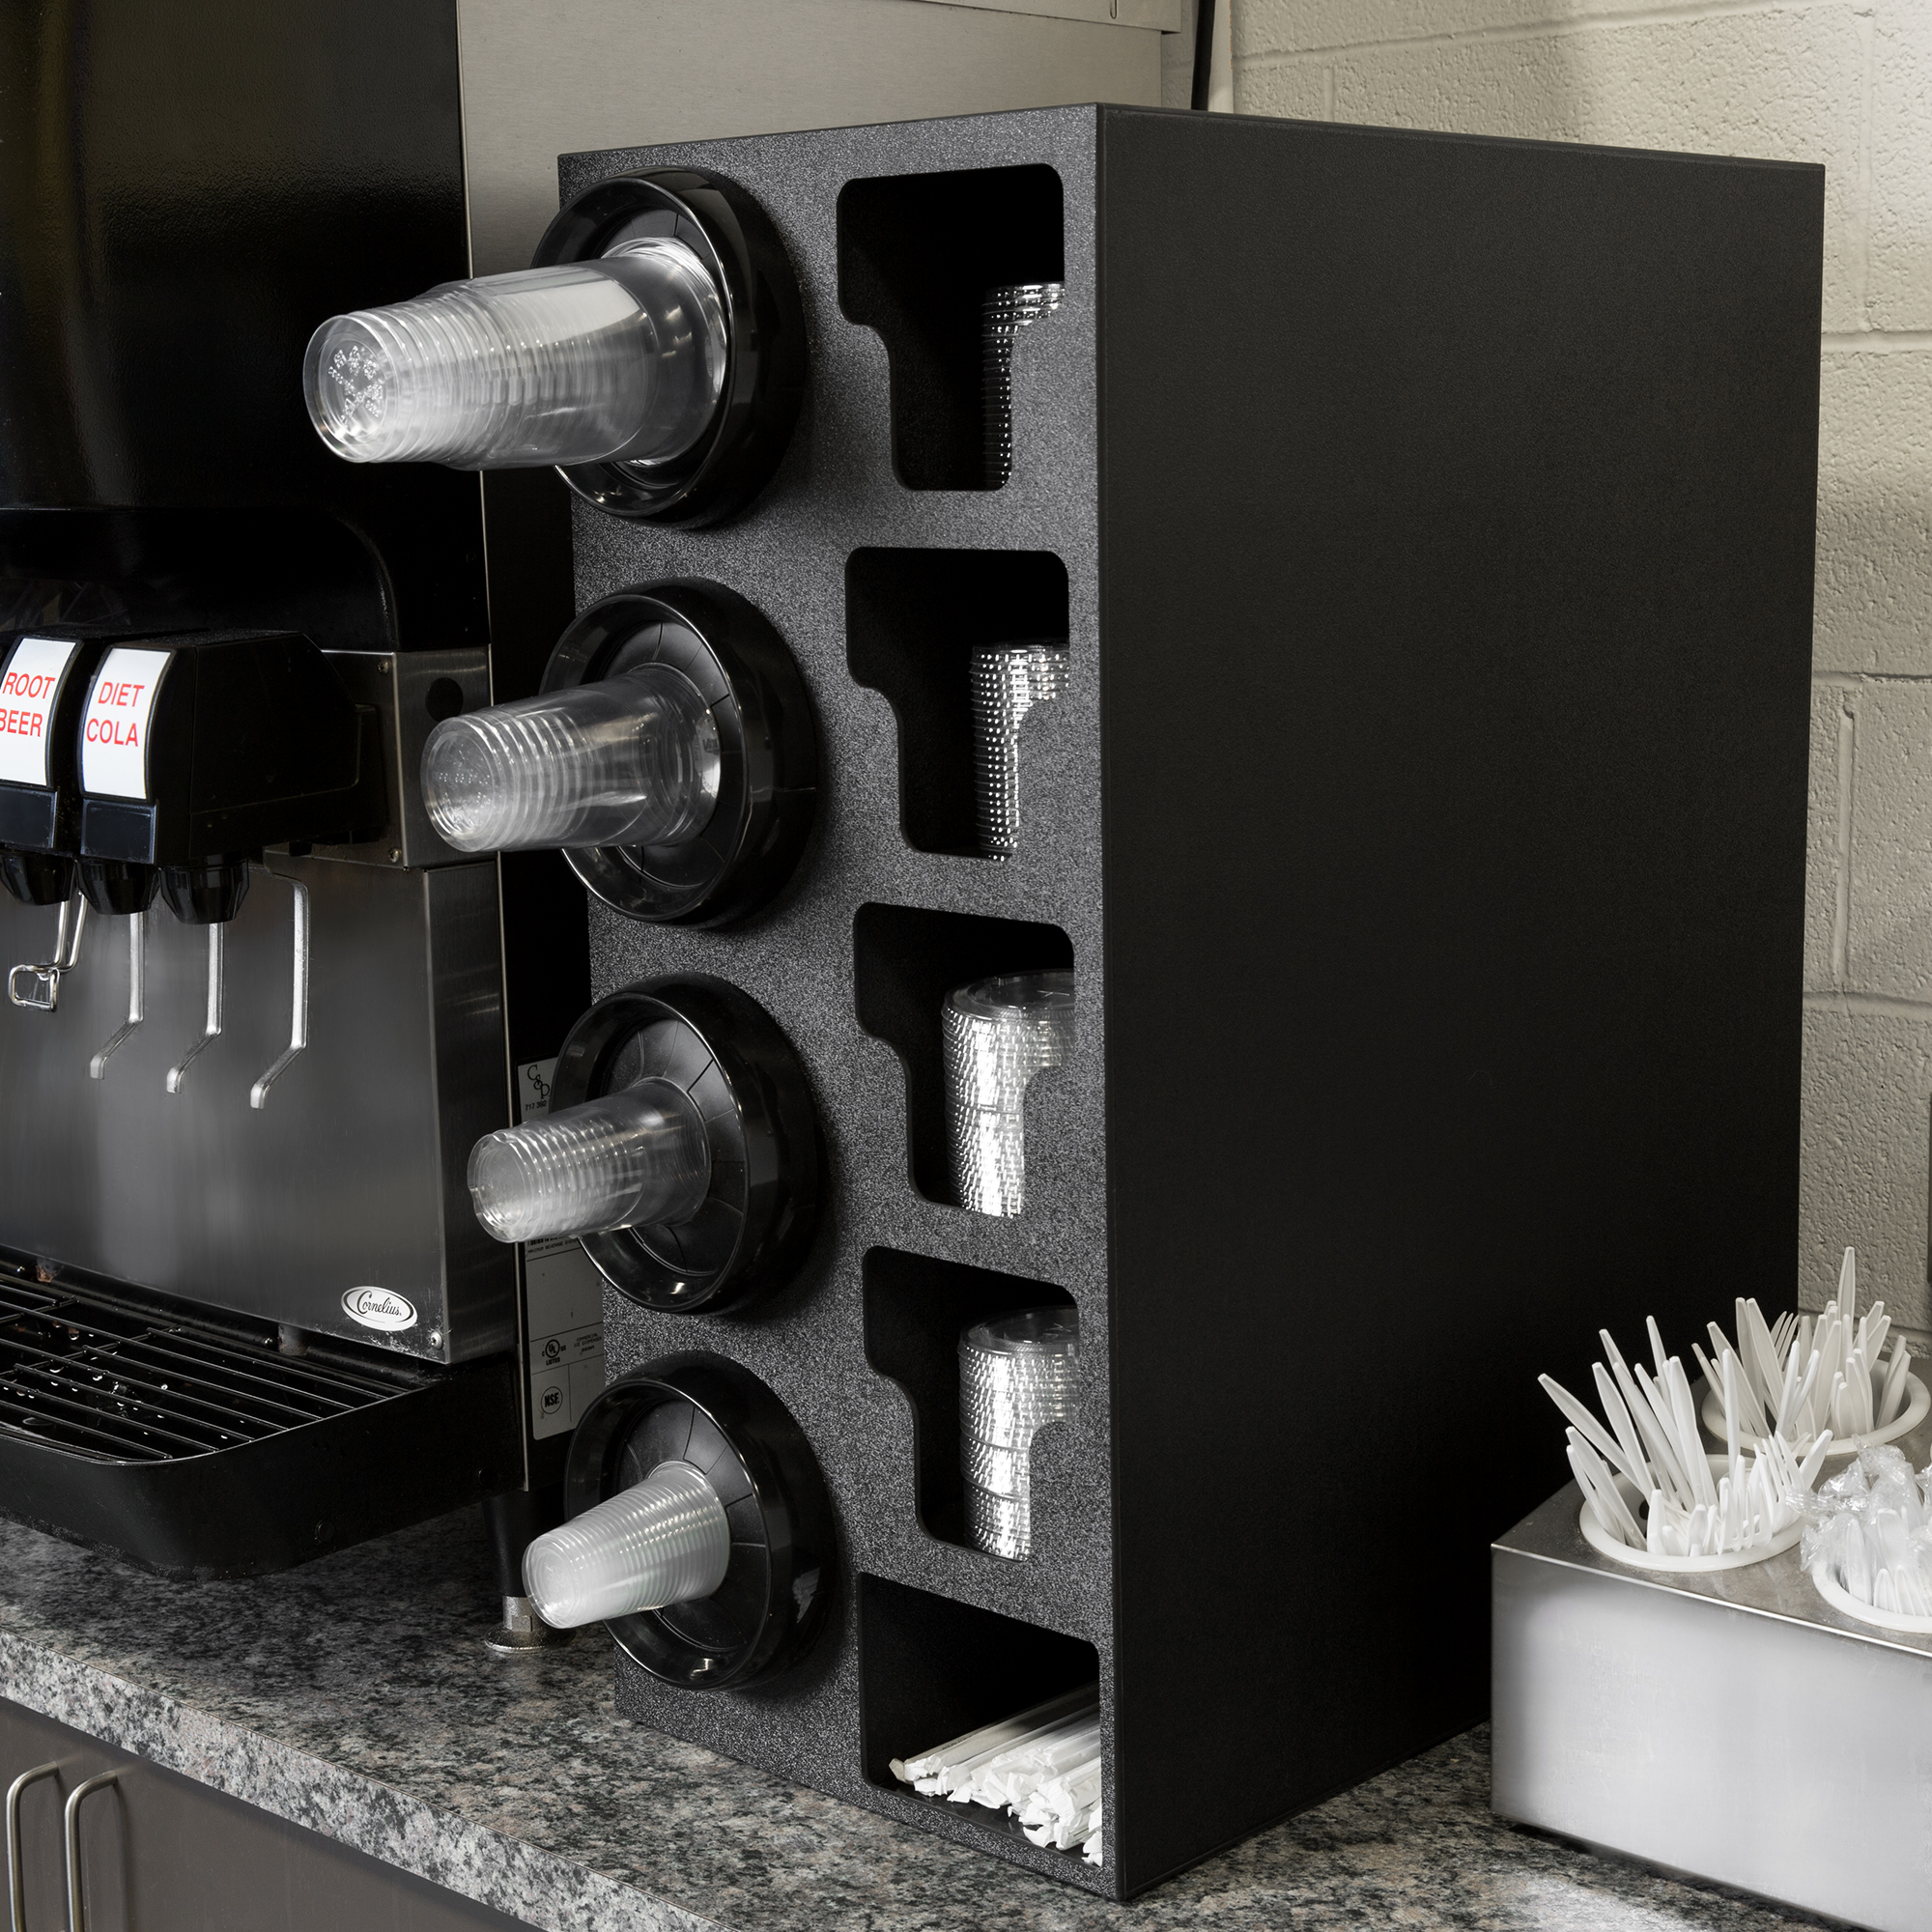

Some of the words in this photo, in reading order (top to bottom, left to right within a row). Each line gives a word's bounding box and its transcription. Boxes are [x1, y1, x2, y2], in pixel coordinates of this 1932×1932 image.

[3, 672, 55, 698] ROOT
[98, 681, 145, 707] DIET
[0, 708, 43, 737] BEER
[86, 718, 138, 747] COLA
[525, 1102, 535, 1111] 717
[356, 1290, 400, 1316] Cornelius
[546, 1356, 560, 1366] LISTED
[544, 1392, 559, 1407] NSF
